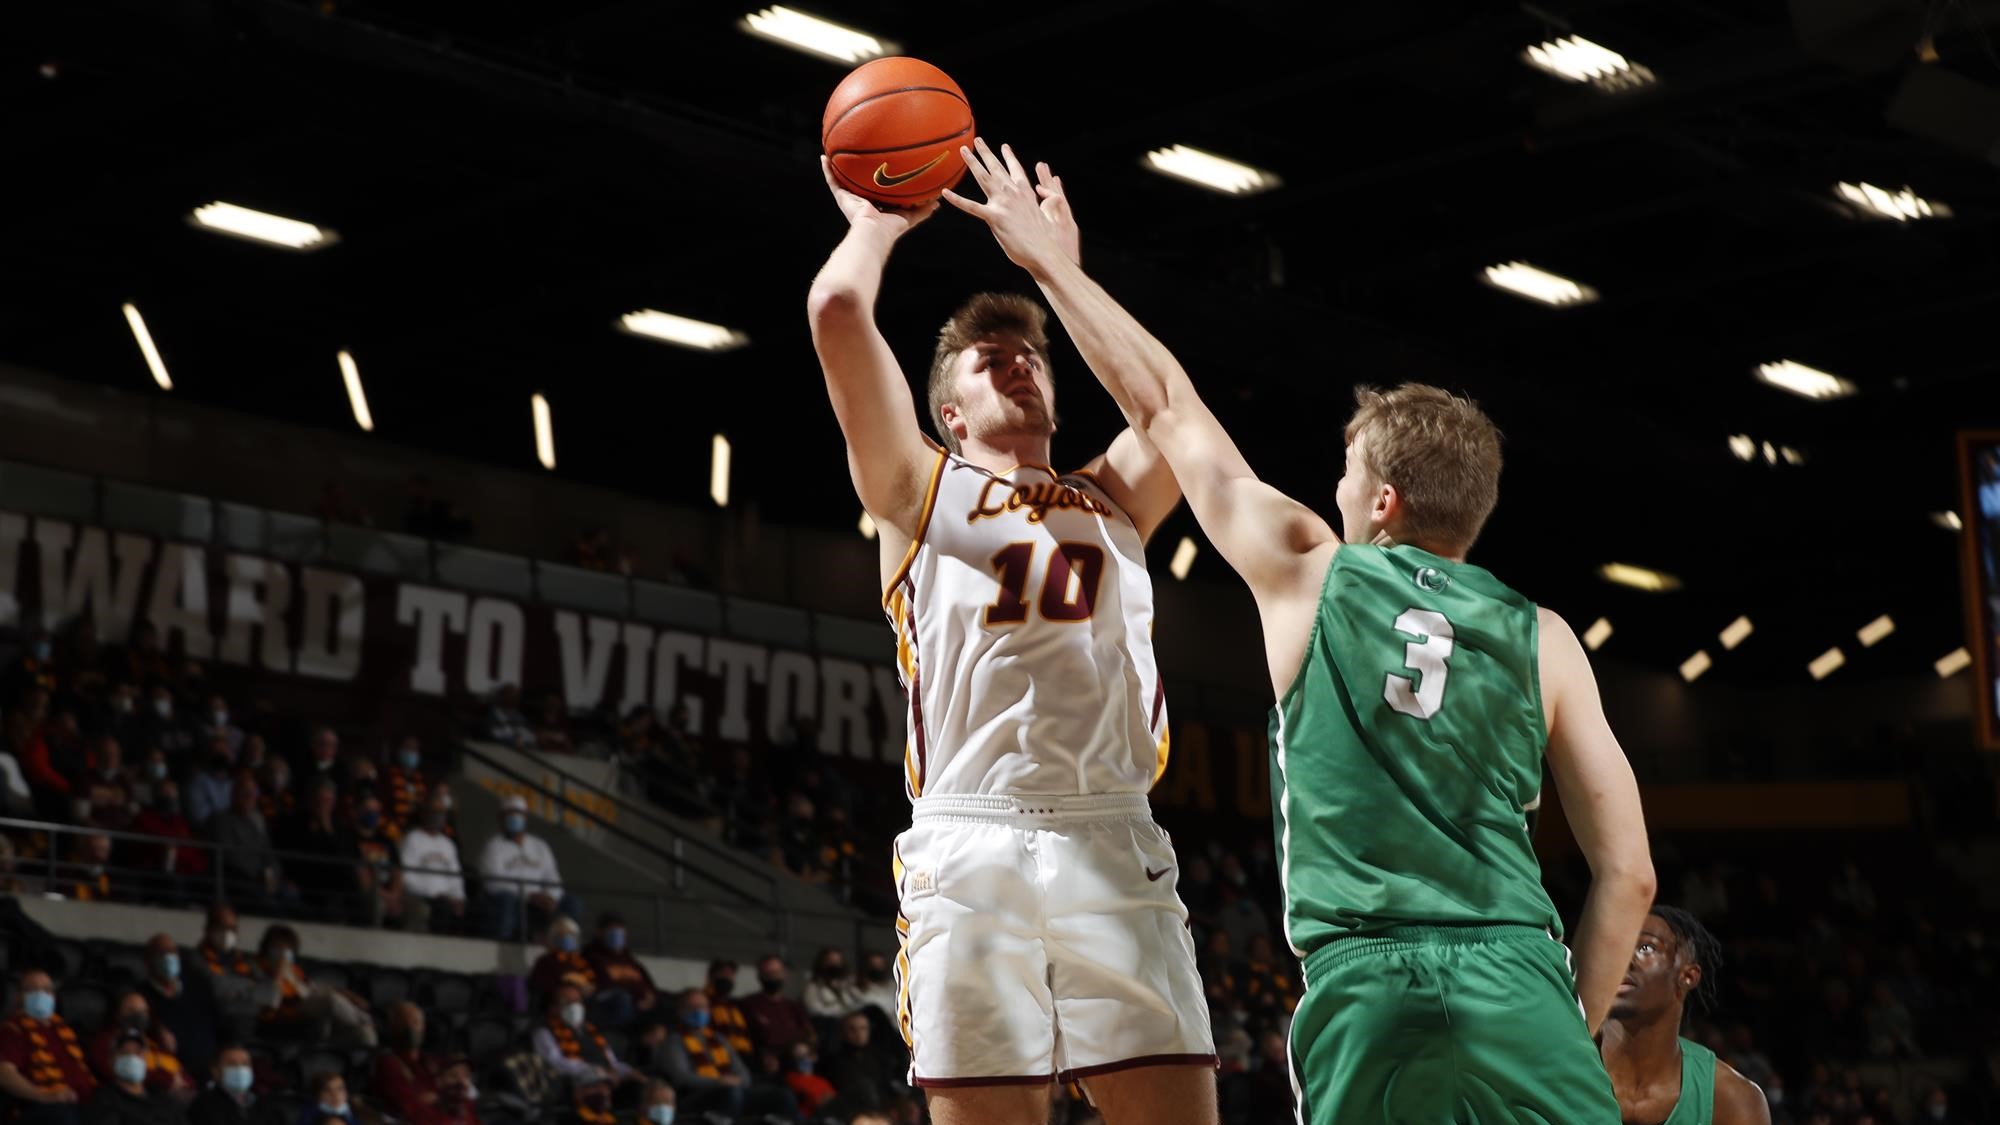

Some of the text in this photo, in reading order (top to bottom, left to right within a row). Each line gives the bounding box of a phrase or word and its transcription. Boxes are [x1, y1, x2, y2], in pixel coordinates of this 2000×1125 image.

[967, 478, 1112, 524] Loyola
[984, 540, 1103, 625] 10
[396, 582, 526, 696] TO
[1383, 607, 1455, 720] 3
